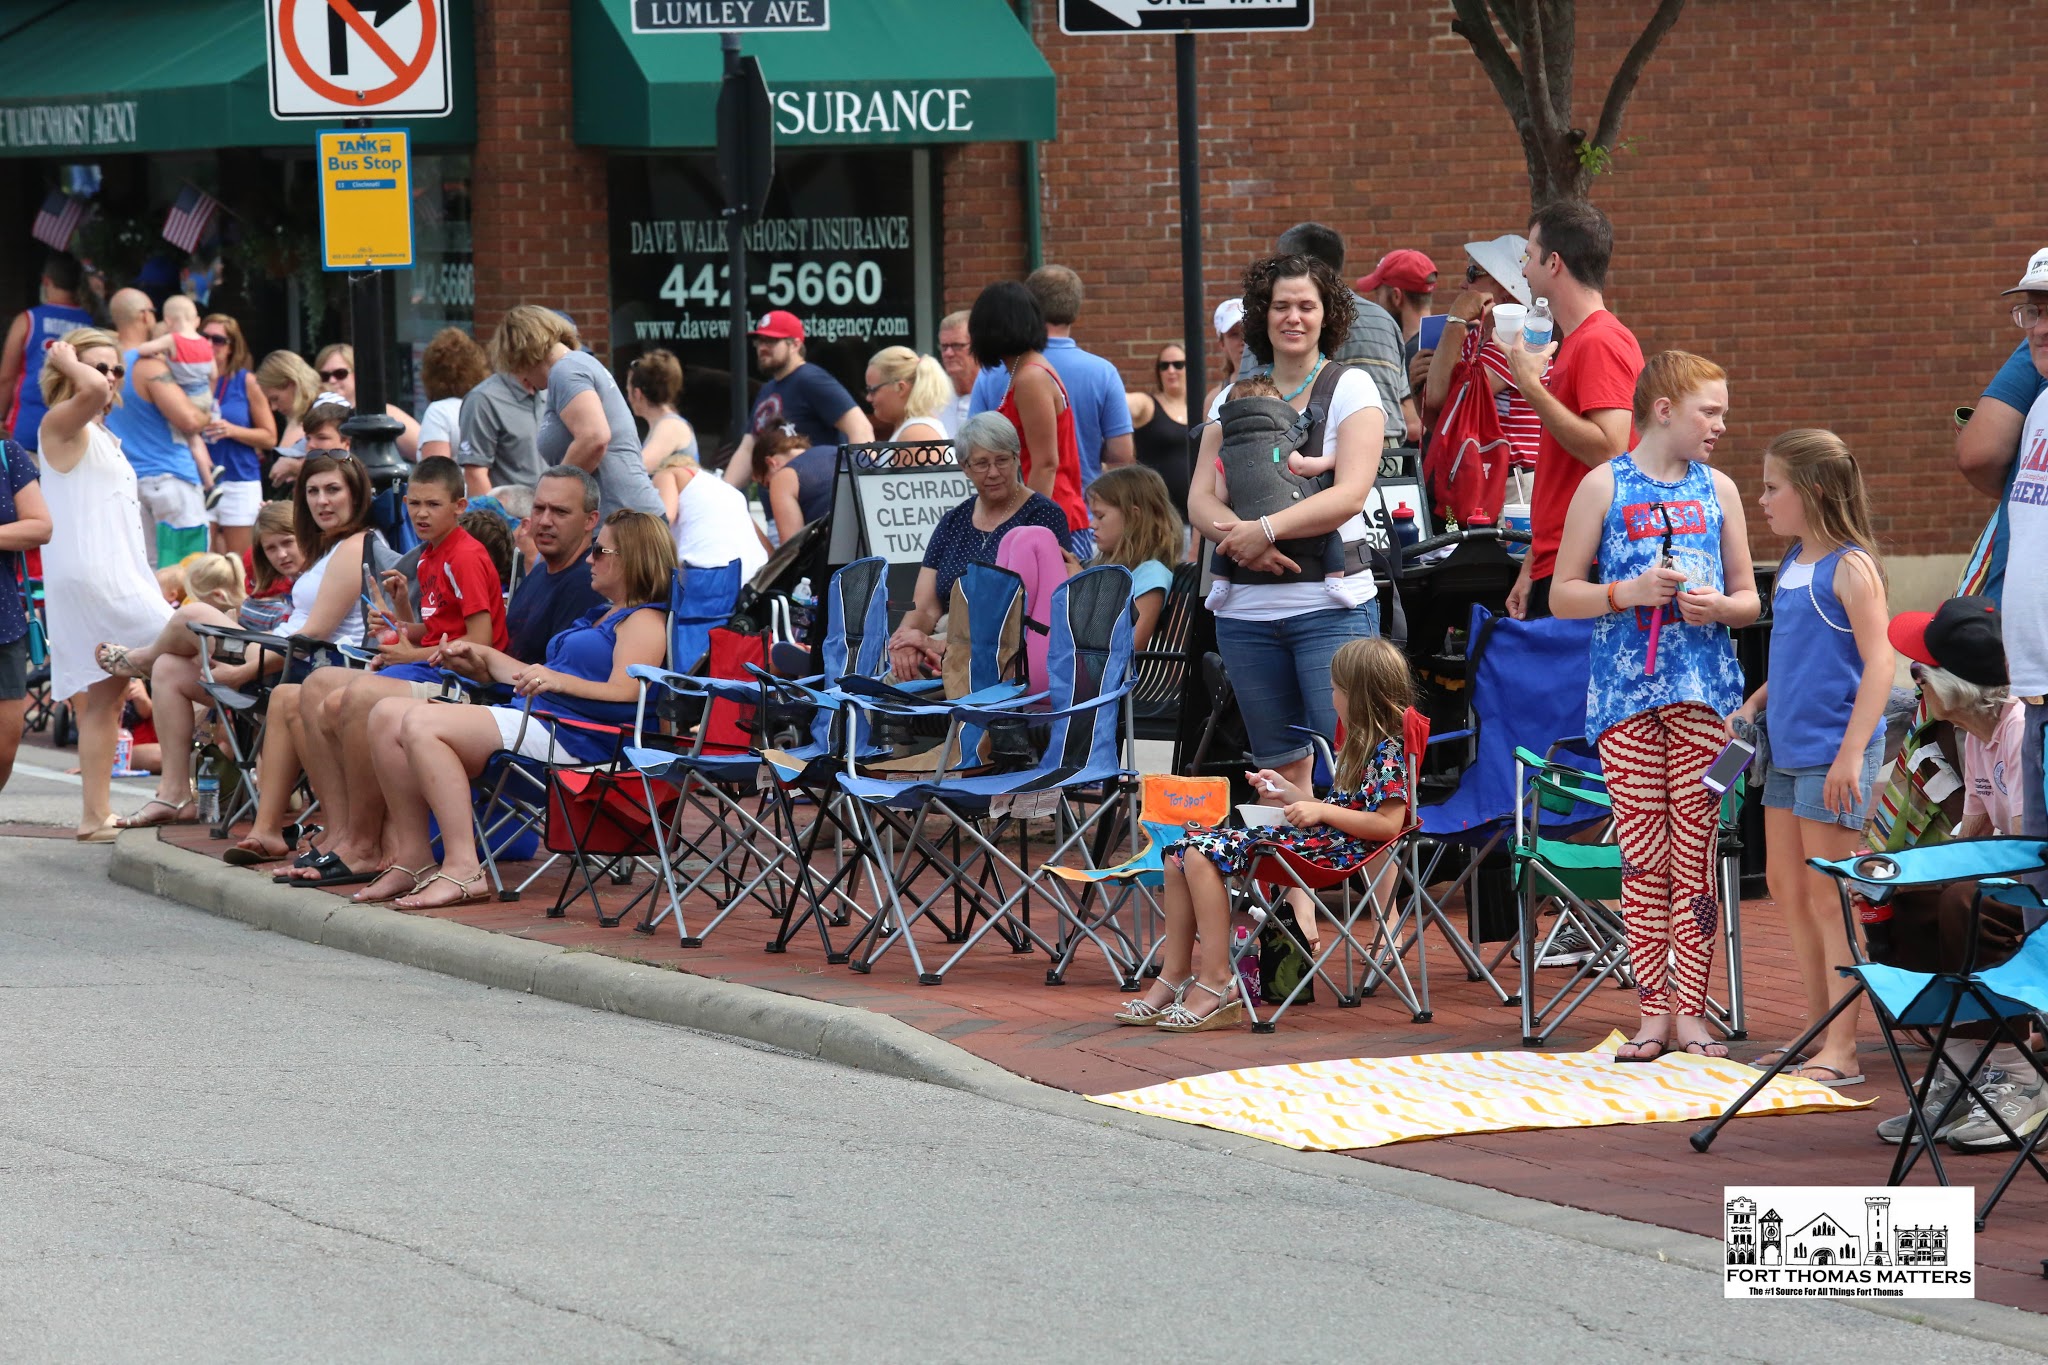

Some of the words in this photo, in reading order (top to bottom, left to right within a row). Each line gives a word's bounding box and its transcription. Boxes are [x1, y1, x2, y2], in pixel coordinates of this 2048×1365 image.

[650, 1, 752, 25] LUMLEY
[764, 1, 815, 24] AVE.
[768, 89, 974, 134] SURANCE
[337, 140, 378, 152] TANK
[327, 156, 358, 170] Bus
[363, 155, 402, 173] Stop
[630, 221, 677, 254] DAVE
[680, 218, 808, 252] WALKNHORST
[811, 215, 910, 250] INSURANCE
[881, 479, 979, 502] SCHRADE
[1629, 504, 1702, 534] #USA
[884, 533, 926, 553] TUX
